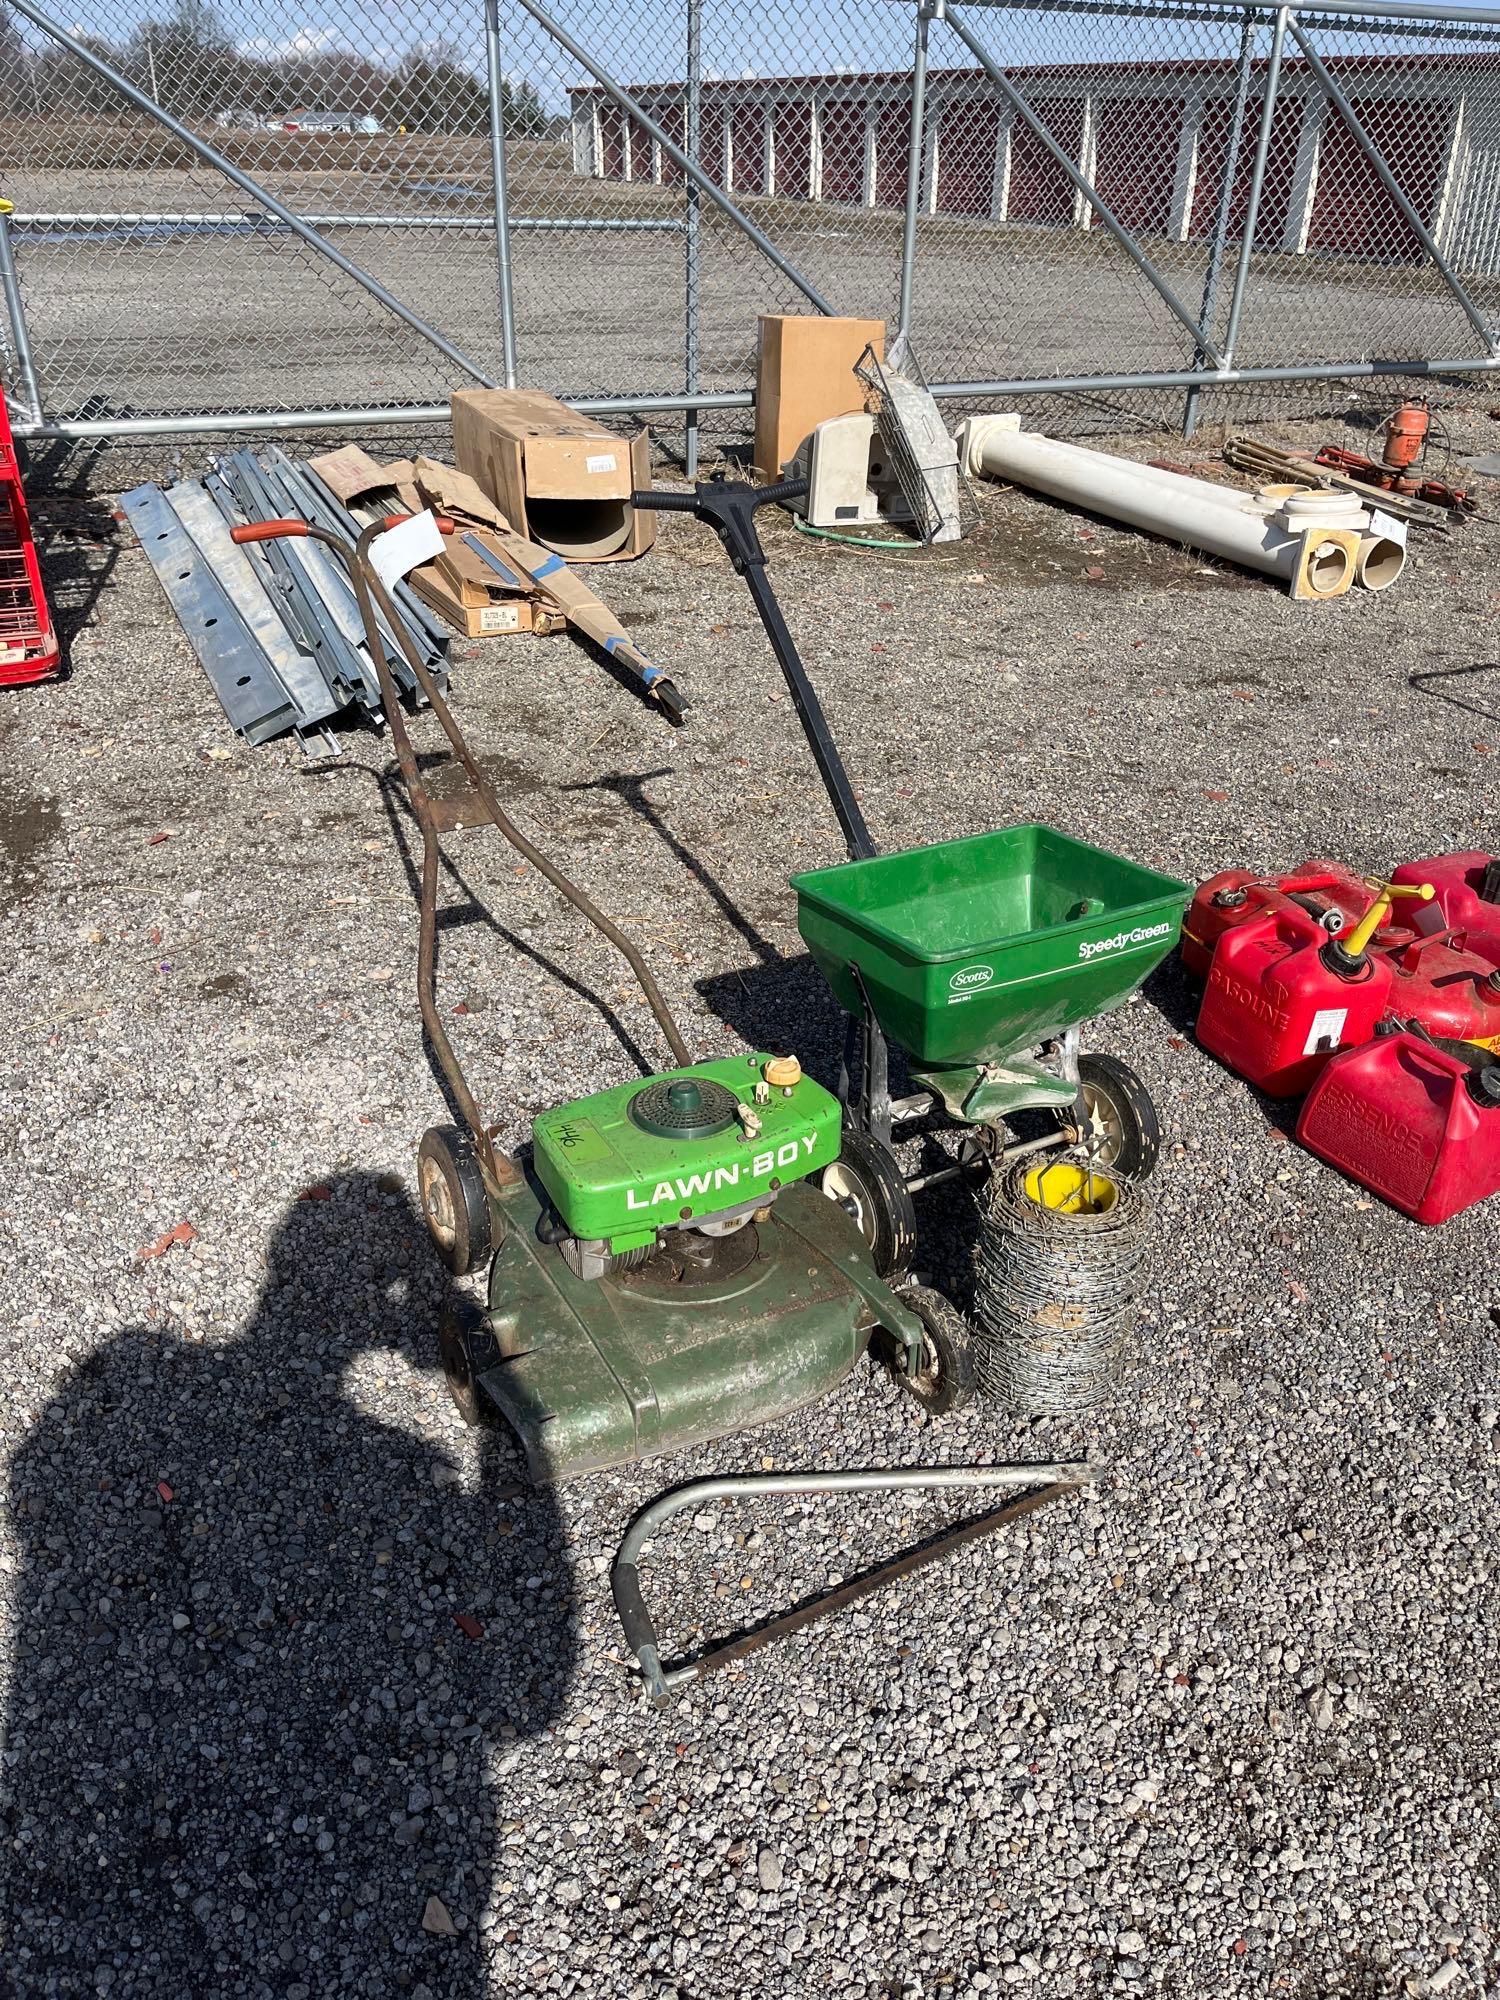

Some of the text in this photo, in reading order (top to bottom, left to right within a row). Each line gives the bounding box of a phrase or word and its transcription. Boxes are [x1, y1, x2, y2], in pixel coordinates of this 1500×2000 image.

[955, 971, 988, 986] Scotts
[1210, 967, 1291, 1032] GASOLINE
[553, 1124, 585, 1147] 446
[626, 1131, 818, 1211] LAWN-BOY
